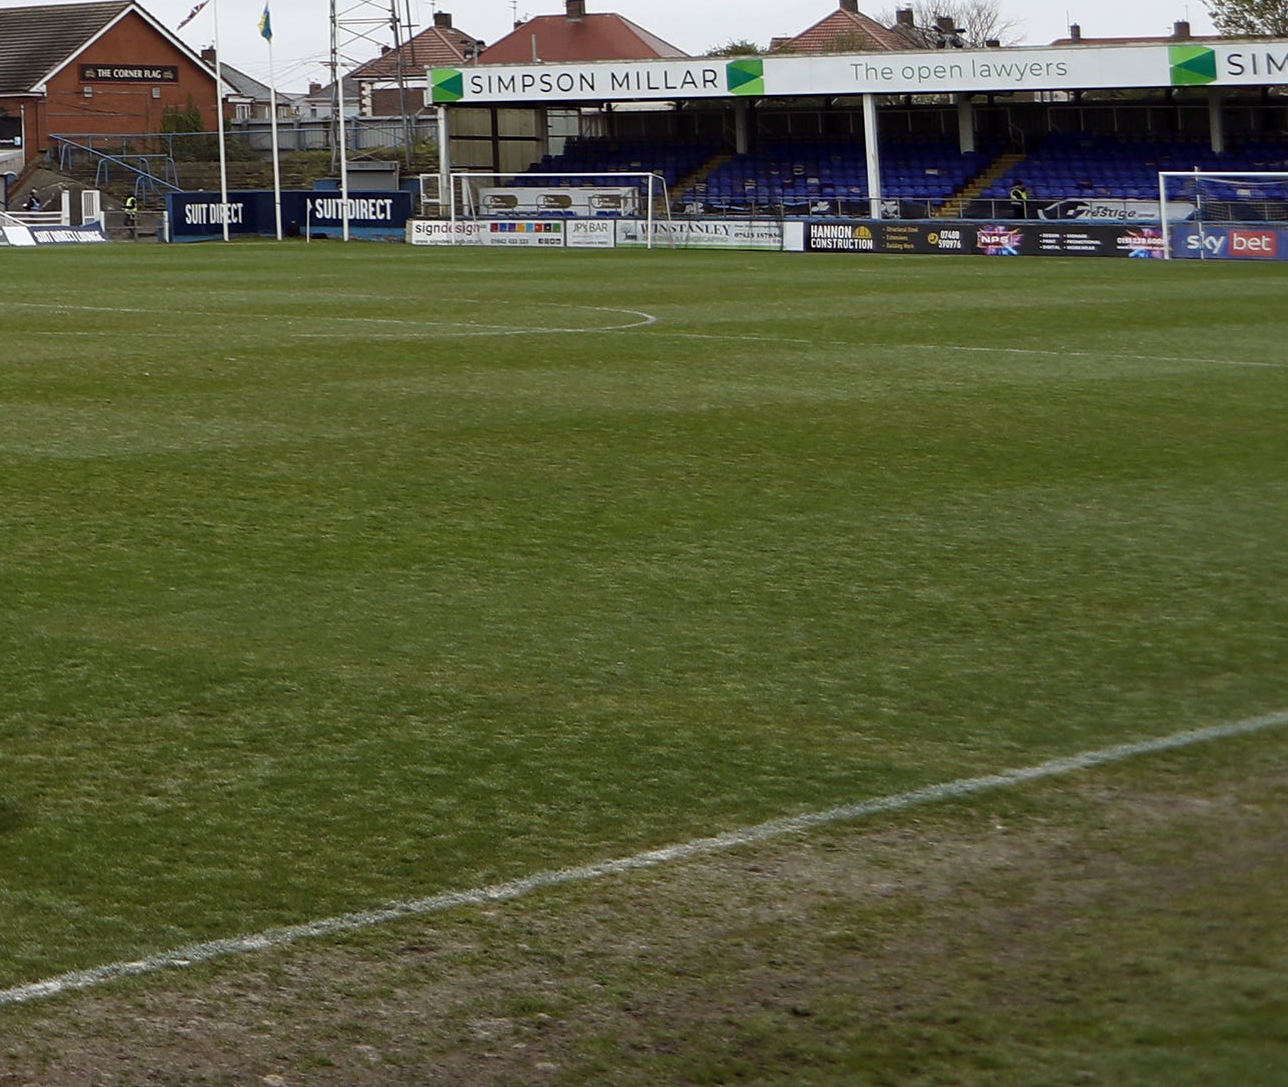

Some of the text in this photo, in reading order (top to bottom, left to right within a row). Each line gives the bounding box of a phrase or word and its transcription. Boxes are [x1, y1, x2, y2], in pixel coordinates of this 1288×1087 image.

[850, 58, 1067, 84] The open lawyers
[1227, 52, 1288, 76] SIM
[97, 68, 162, 79] THE CORNER FLAG
[470, 68, 719, 94] SIMPSON MILLAR
[185, 202, 244, 224] SUIT DIRECT
[315, 198, 393, 220] SUIT DIRECT
[414, 221, 480, 236] signdesign
[573, 222, 608, 232] JP's BAR
[810, 225, 853, 238] HANNON
[33, 230, 106, 243] SUIT DIRECT LOUNGE
[810, 238, 873, 250] CONSTRUCTION
[981, 236, 1009, 244] NPS
[1186, 230, 1272, 255] sky bet
